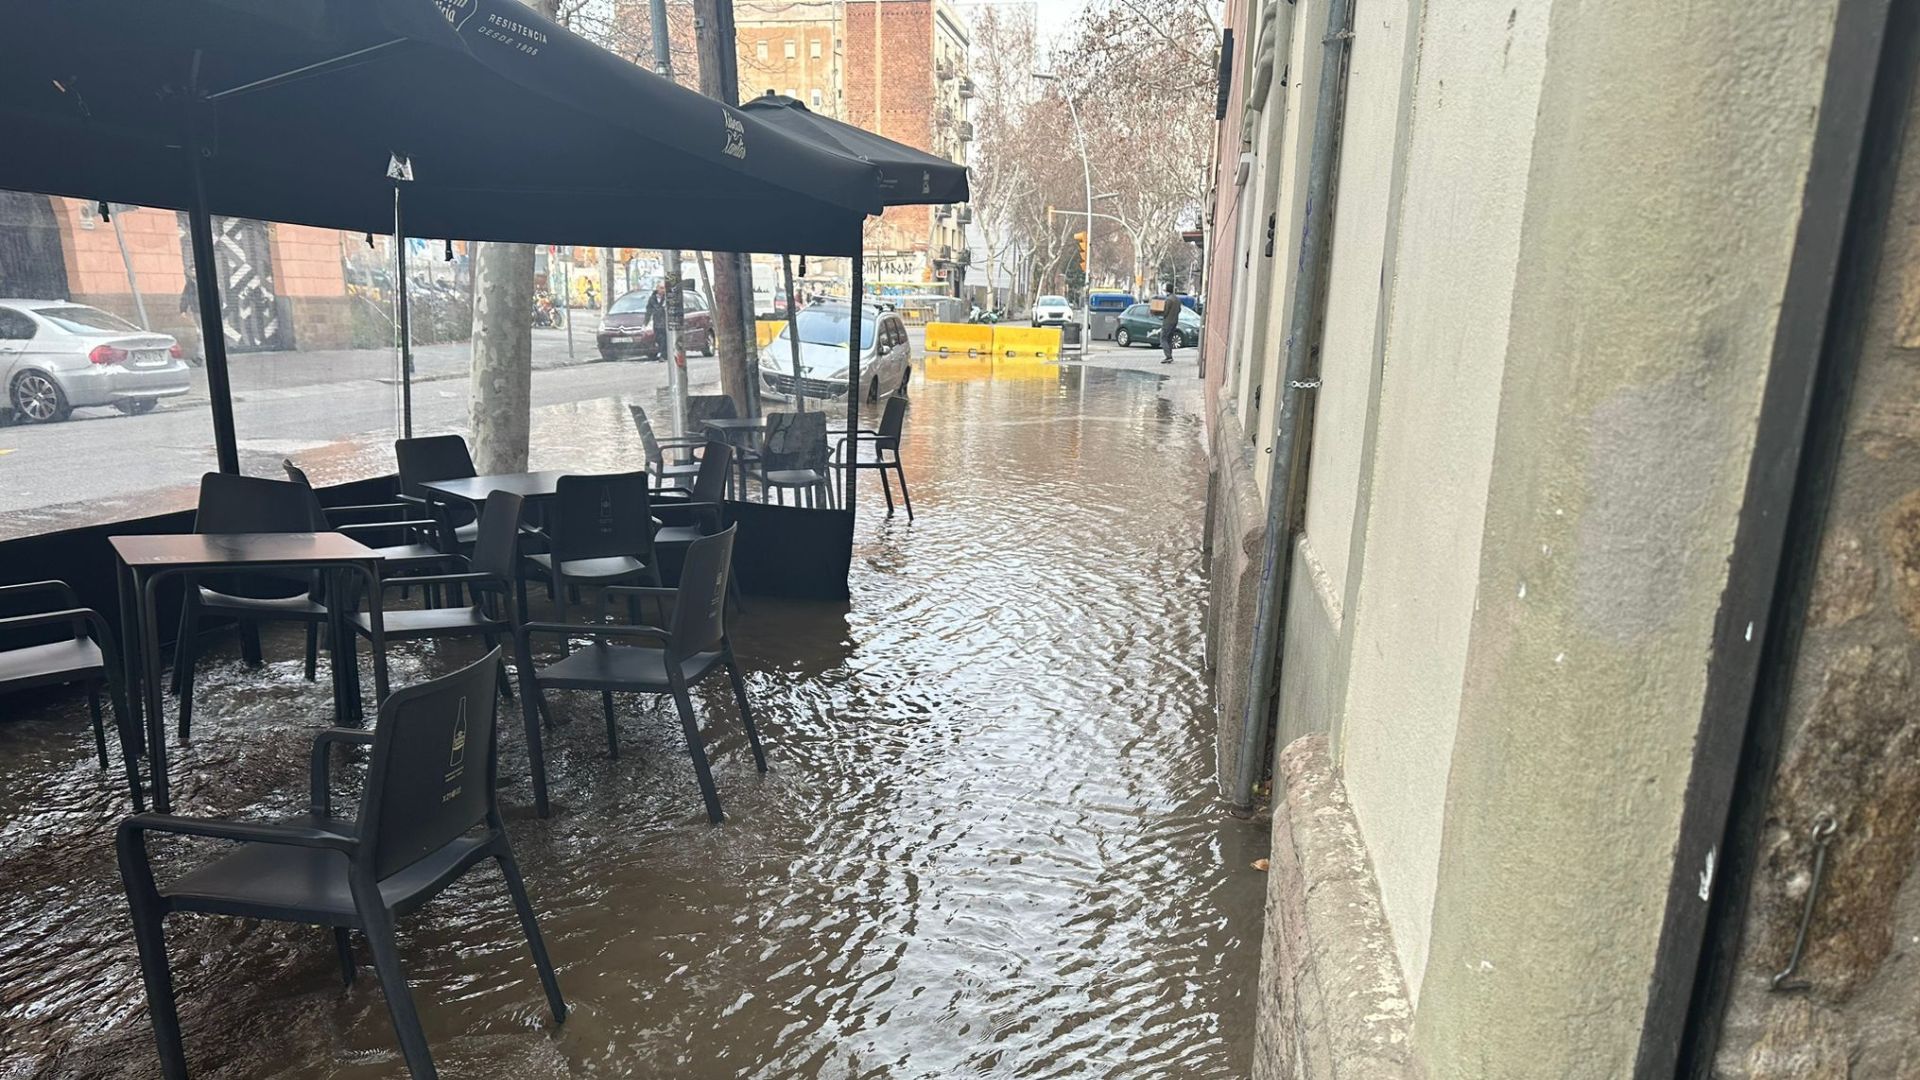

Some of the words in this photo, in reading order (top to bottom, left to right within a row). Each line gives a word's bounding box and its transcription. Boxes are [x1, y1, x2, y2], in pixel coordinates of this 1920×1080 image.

[477, 25, 514, 46] DESDE
[515, 42, 539, 56] 1906
[488, 13, 548, 45] RESISTENCIA
